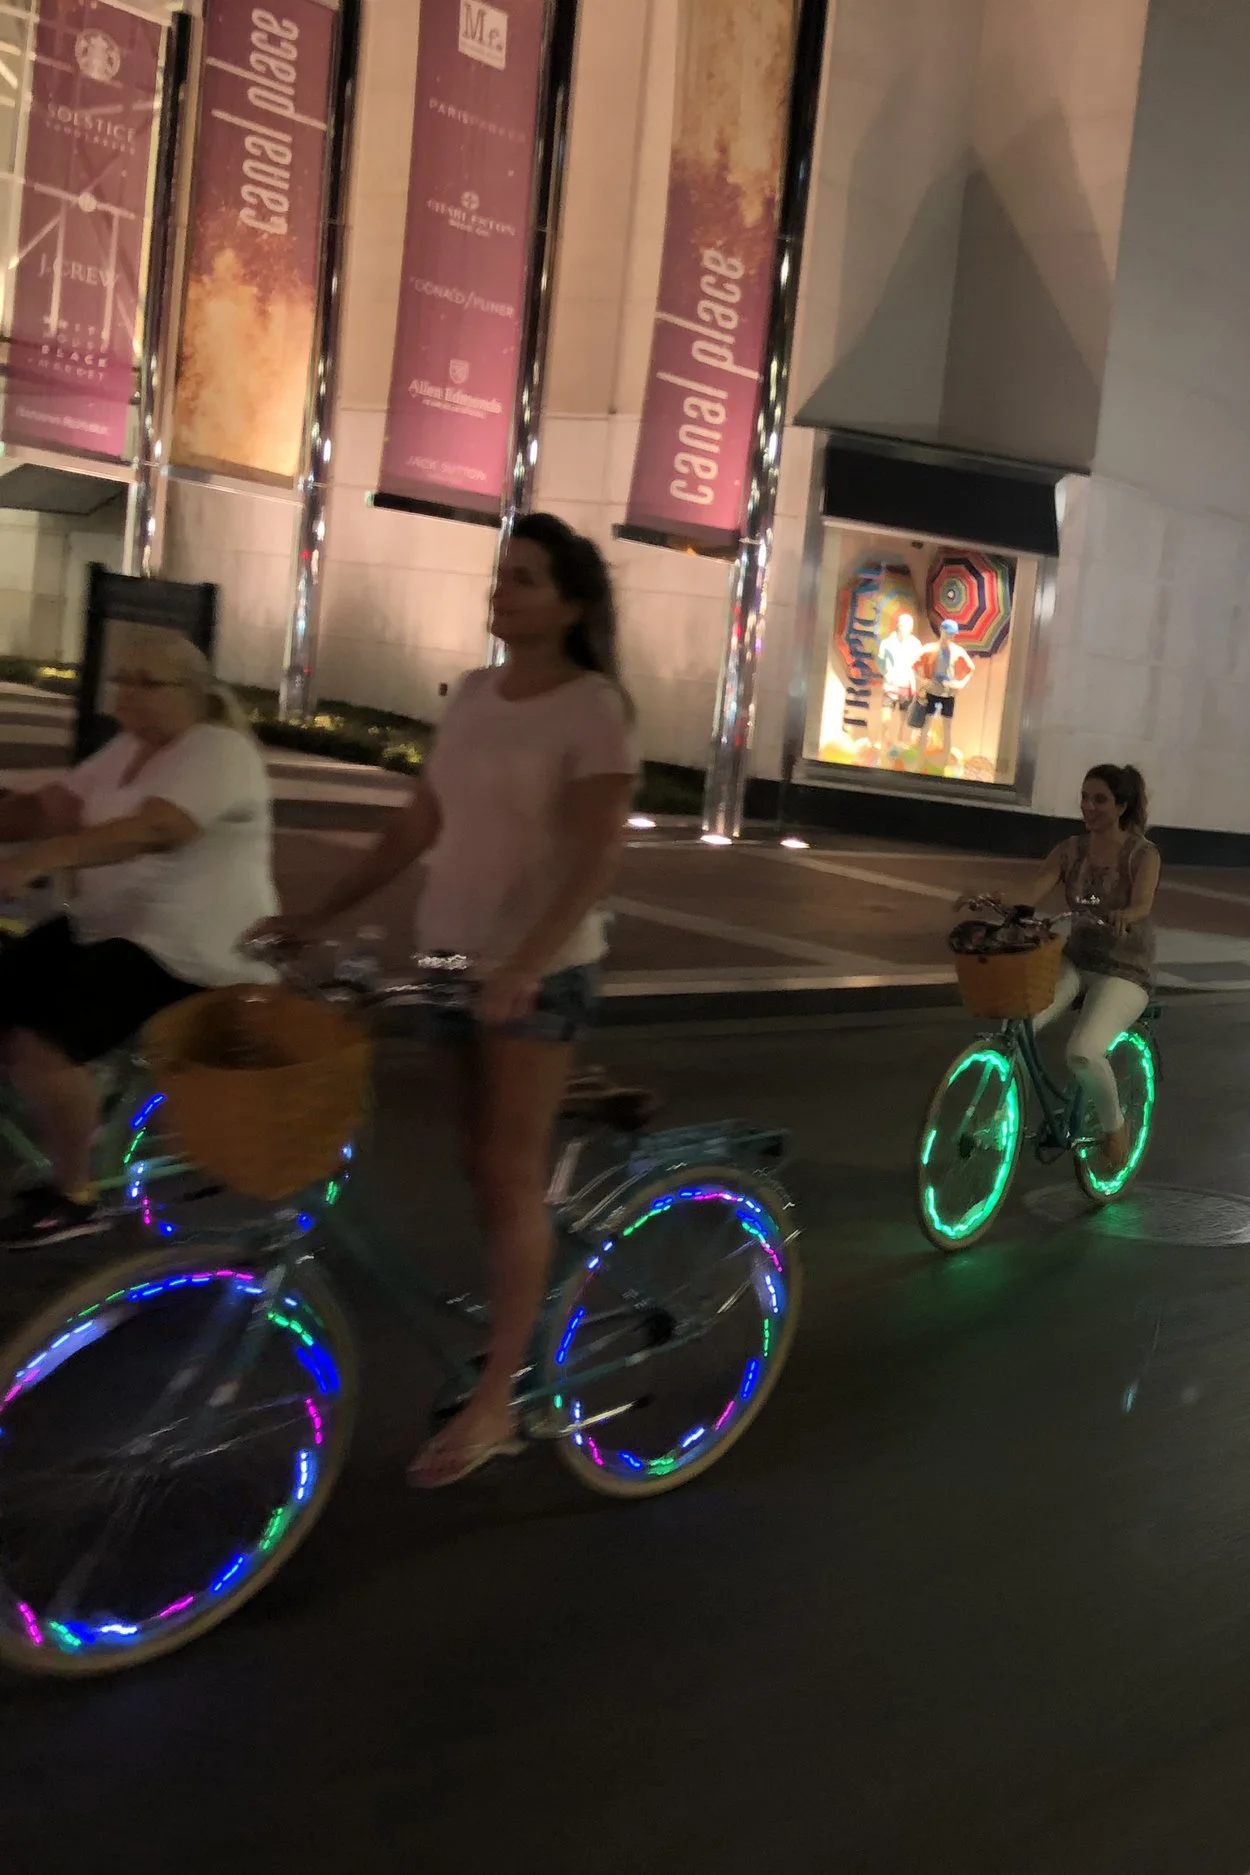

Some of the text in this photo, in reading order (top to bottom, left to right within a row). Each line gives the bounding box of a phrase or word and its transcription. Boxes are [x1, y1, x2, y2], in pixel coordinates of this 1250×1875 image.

[204, 8, 327, 236] canal place
[655, 247, 762, 505] canal place
